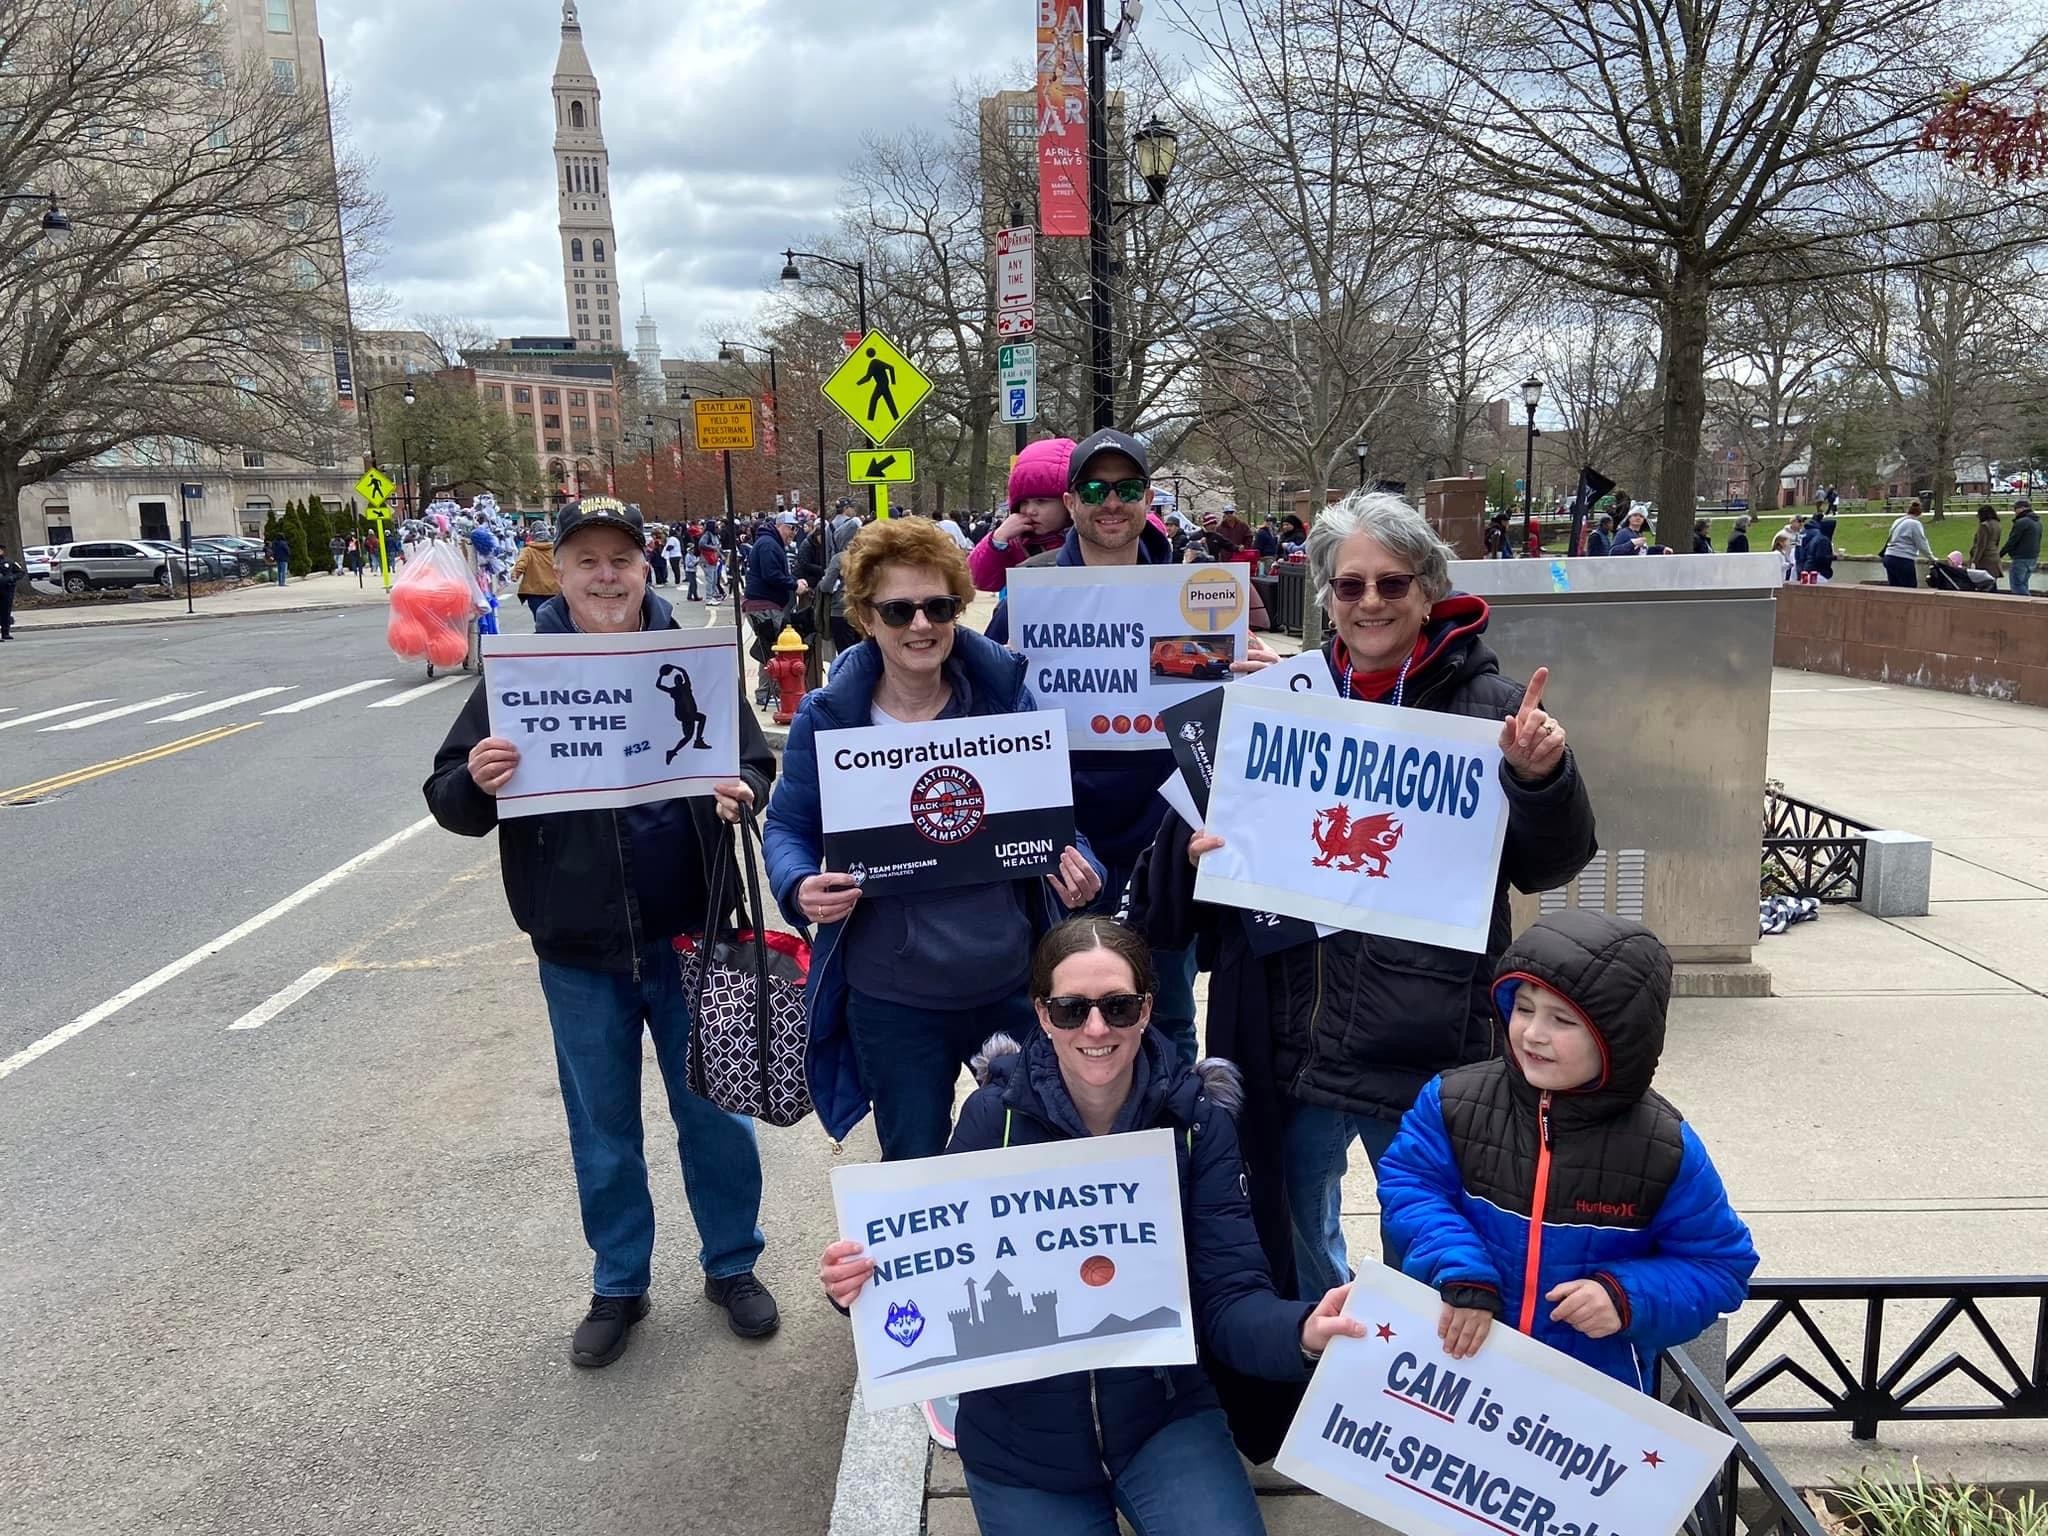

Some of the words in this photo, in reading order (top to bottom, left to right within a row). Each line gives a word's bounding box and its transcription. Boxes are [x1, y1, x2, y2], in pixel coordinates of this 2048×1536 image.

[1045, 147, 1072, 156] APRIL
[1053, 157, 1074, 166] MAY
[999, 235, 1008, 252] NO
[1008, 234, 1031, 247] PARKING
[1008, 259, 1023, 271] ANY
[1008, 273, 1024, 286] TIME
[1002, 349, 1012, 366] 4
[701, 403, 726, 412] STATE
[727, 402, 746, 411] LAW
[710, 416, 729, 425] YIELD
[731, 415, 740, 424] TO
[703, 426, 747, 435] PEDESTRIANS
[711, 436, 750, 444] CROSSWALK
[1190, 589, 1236, 601] Phoenix
[1022, 622, 1145, 649] KARABAN'S
[1038, 668, 1138, 694] CARAVAN
[501, 688, 633, 707] CLINGAN
[521, 716, 560, 733] TO
[569, 715, 627, 731] THE
[550, 742, 603, 758] RIM
[623, 740, 652, 757] #32
[834, 730, 1052, 771] Congratulations!
[1245, 721, 1331, 793] DAN'S
[1334, 737, 1484, 819] DRAGONS
[916, 768, 972, 793] NATIONAL
[912, 802, 939, 812] BACK
[955, 797, 982, 807] BACK
[916, 810, 981, 841] CHAMPIONS
[995, 839, 1053, 858] UCONN
[868, 865, 890, 874] TEAM
[892, 859, 938, 871] PHYSICIANS
[1003, 854, 1048, 868] HEALTH
[866, 1200, 969, 1247] EVERY
[990, 1182, 1140, 1219] DYNASTY
[1576, 1199, 1621, 1216] Hurley
[873, 1242, 976, 1287] NEEDS
[995, 1236, 1017, 1259] A
[1035, 1222, 1158, 1253] CASTLE
[1386, 1351, 1471, 1417] CAM
[1467, 1387, 1504, 1432] is
[1507, 1414, 1629, 1497] simply
